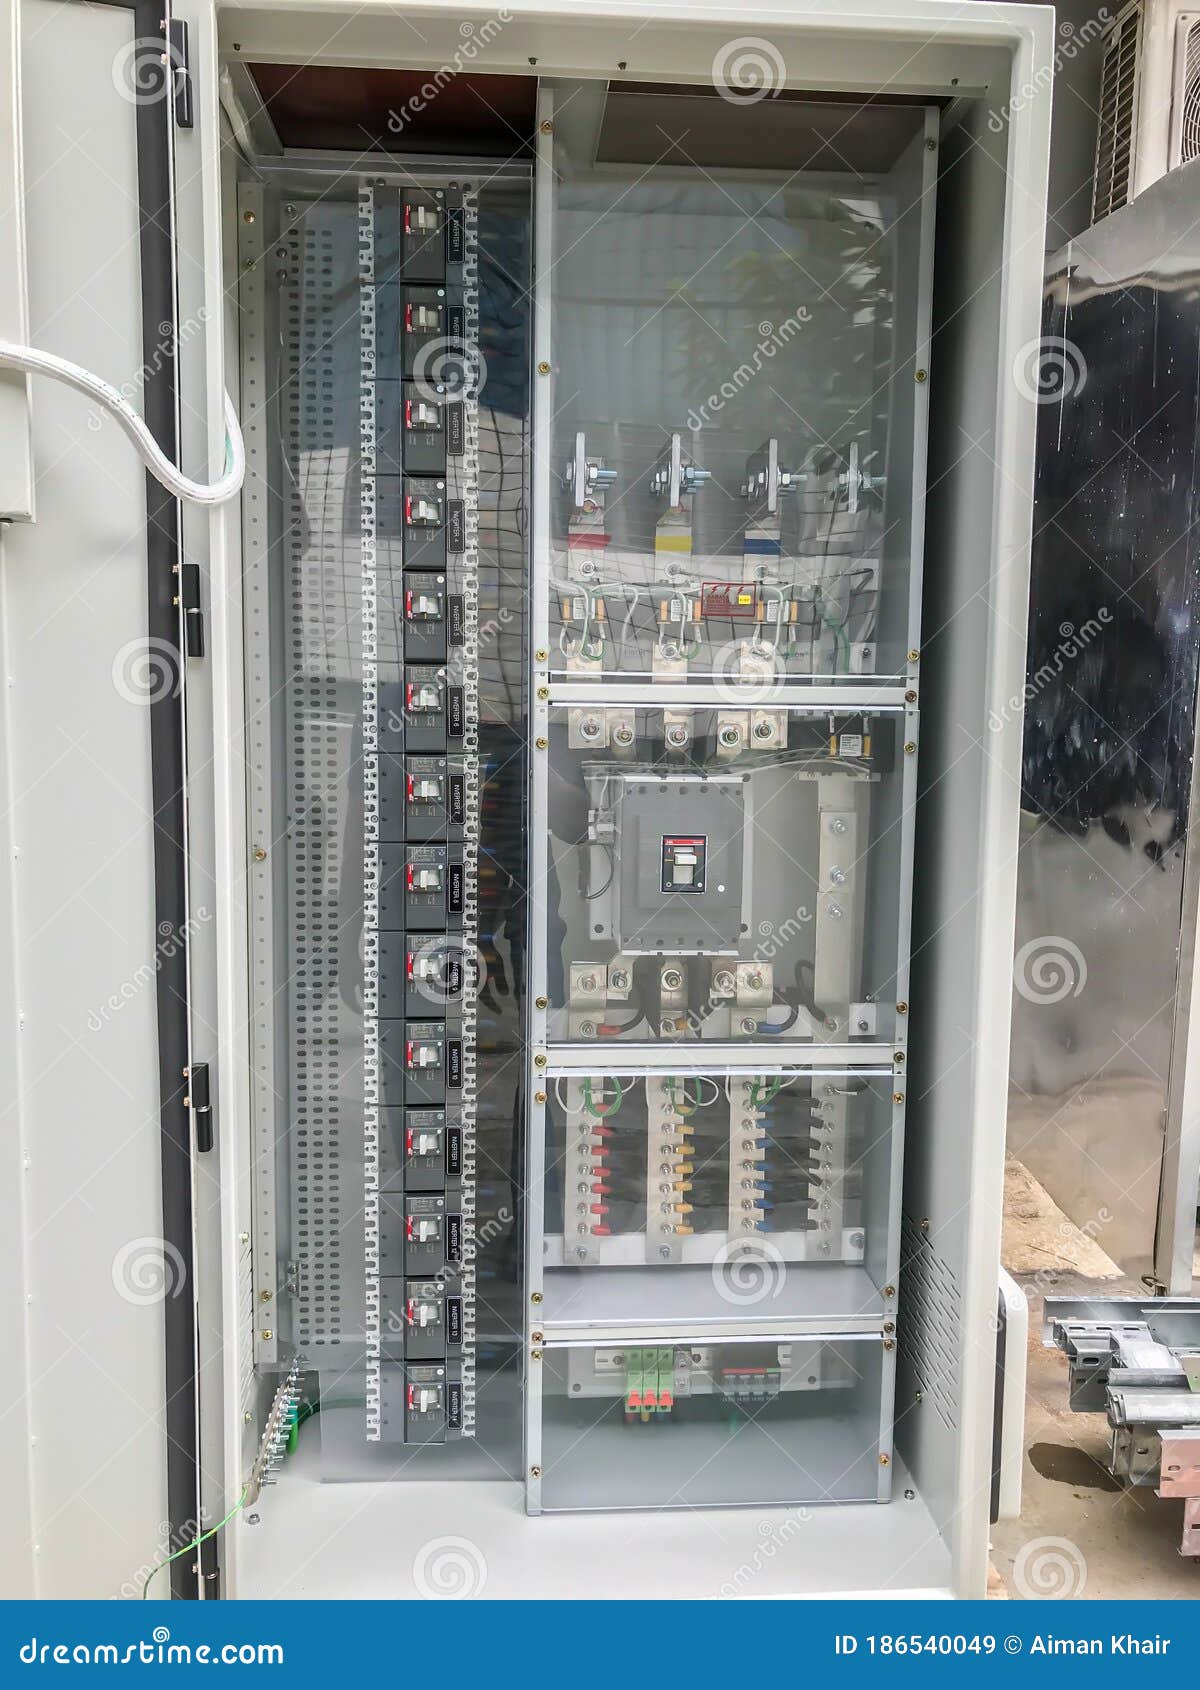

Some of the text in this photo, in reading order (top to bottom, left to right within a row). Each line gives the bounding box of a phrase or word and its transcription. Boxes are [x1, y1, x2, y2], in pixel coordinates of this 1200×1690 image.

[452, 220, 460, 247] INVERTER
[452, 317, 460, 344] INVERTER
[451, 412, 459, 440] INVERTER
[452, 510, 460, 538] INVERTER
[452, 605, 460, 631] INVERTER
[452, 696, 460, 722] INVERTER
[452, 784, 460, 810] INVERTER
[450, 961, 458, 986] INVERTER
[450, 1049, 458, 1073] INVERTER
[450, 1136, 458, 1160] INVERTER
[450, 1223, 458, 1246] INVERTER
